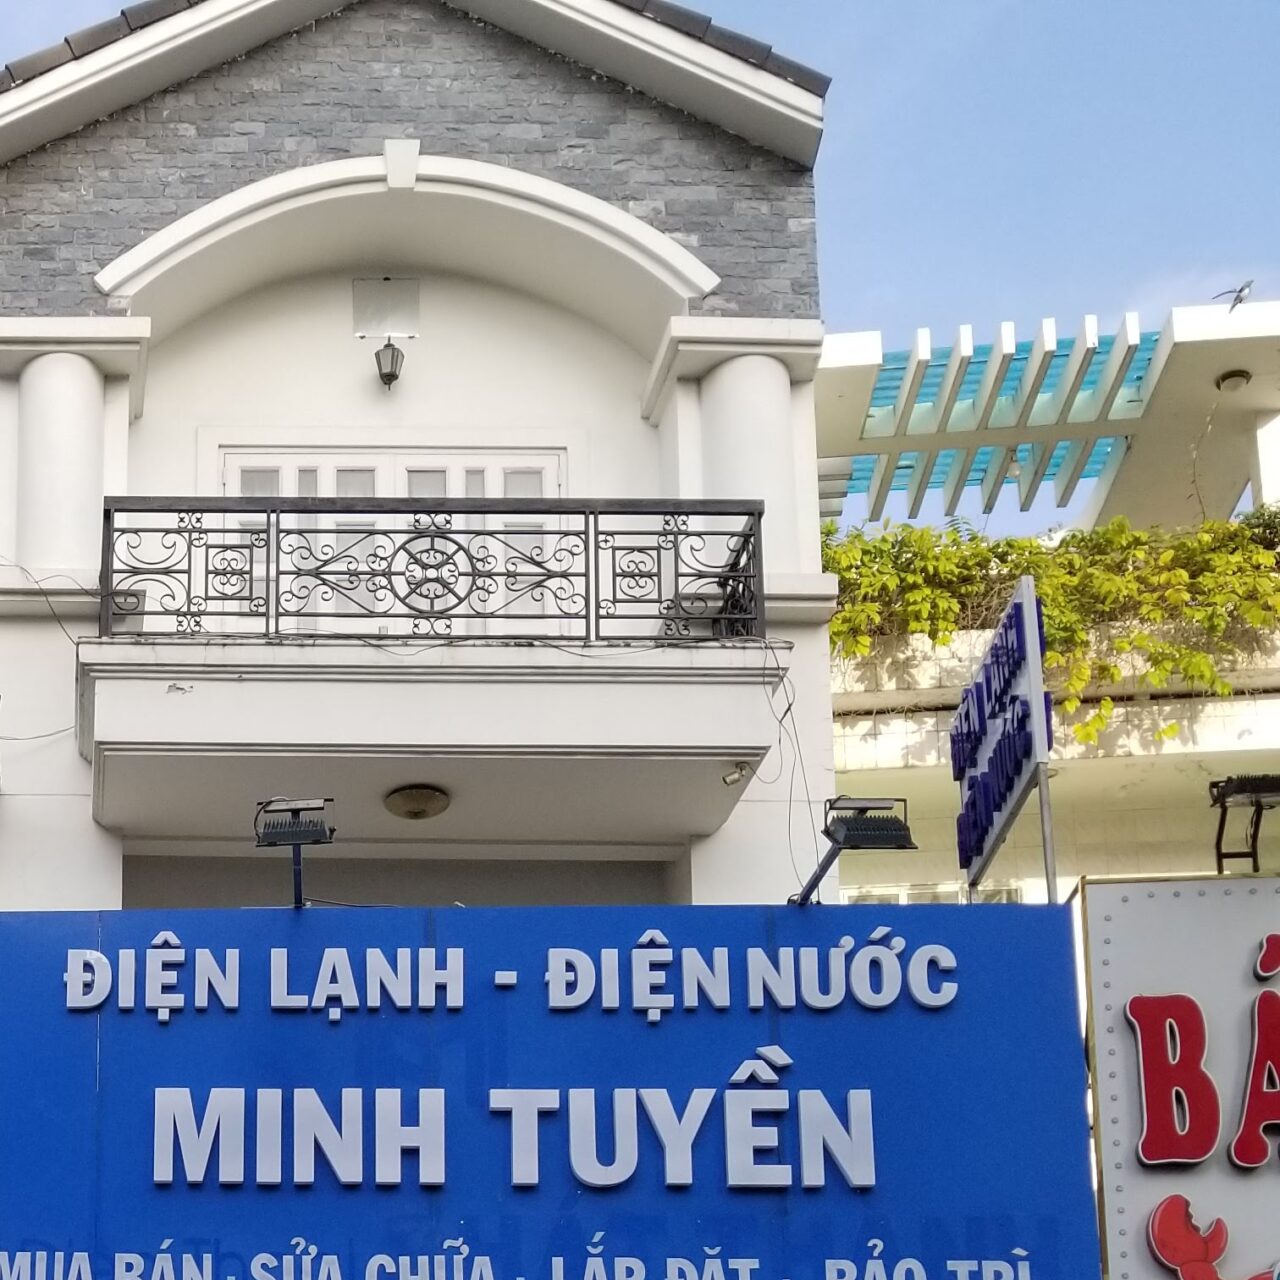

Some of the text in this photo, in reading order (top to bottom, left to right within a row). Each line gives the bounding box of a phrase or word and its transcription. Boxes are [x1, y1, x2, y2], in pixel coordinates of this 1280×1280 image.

[63, 930, 240, 1022] ĐIỆN
[270, 947, 464, 1022] LẠNH
[544, 929, 731, 1023] ĐIỆN
[746, 925, 959, 1010] NƯỚC
[153, 1044, 876, 1188] MINH TUYỀN
